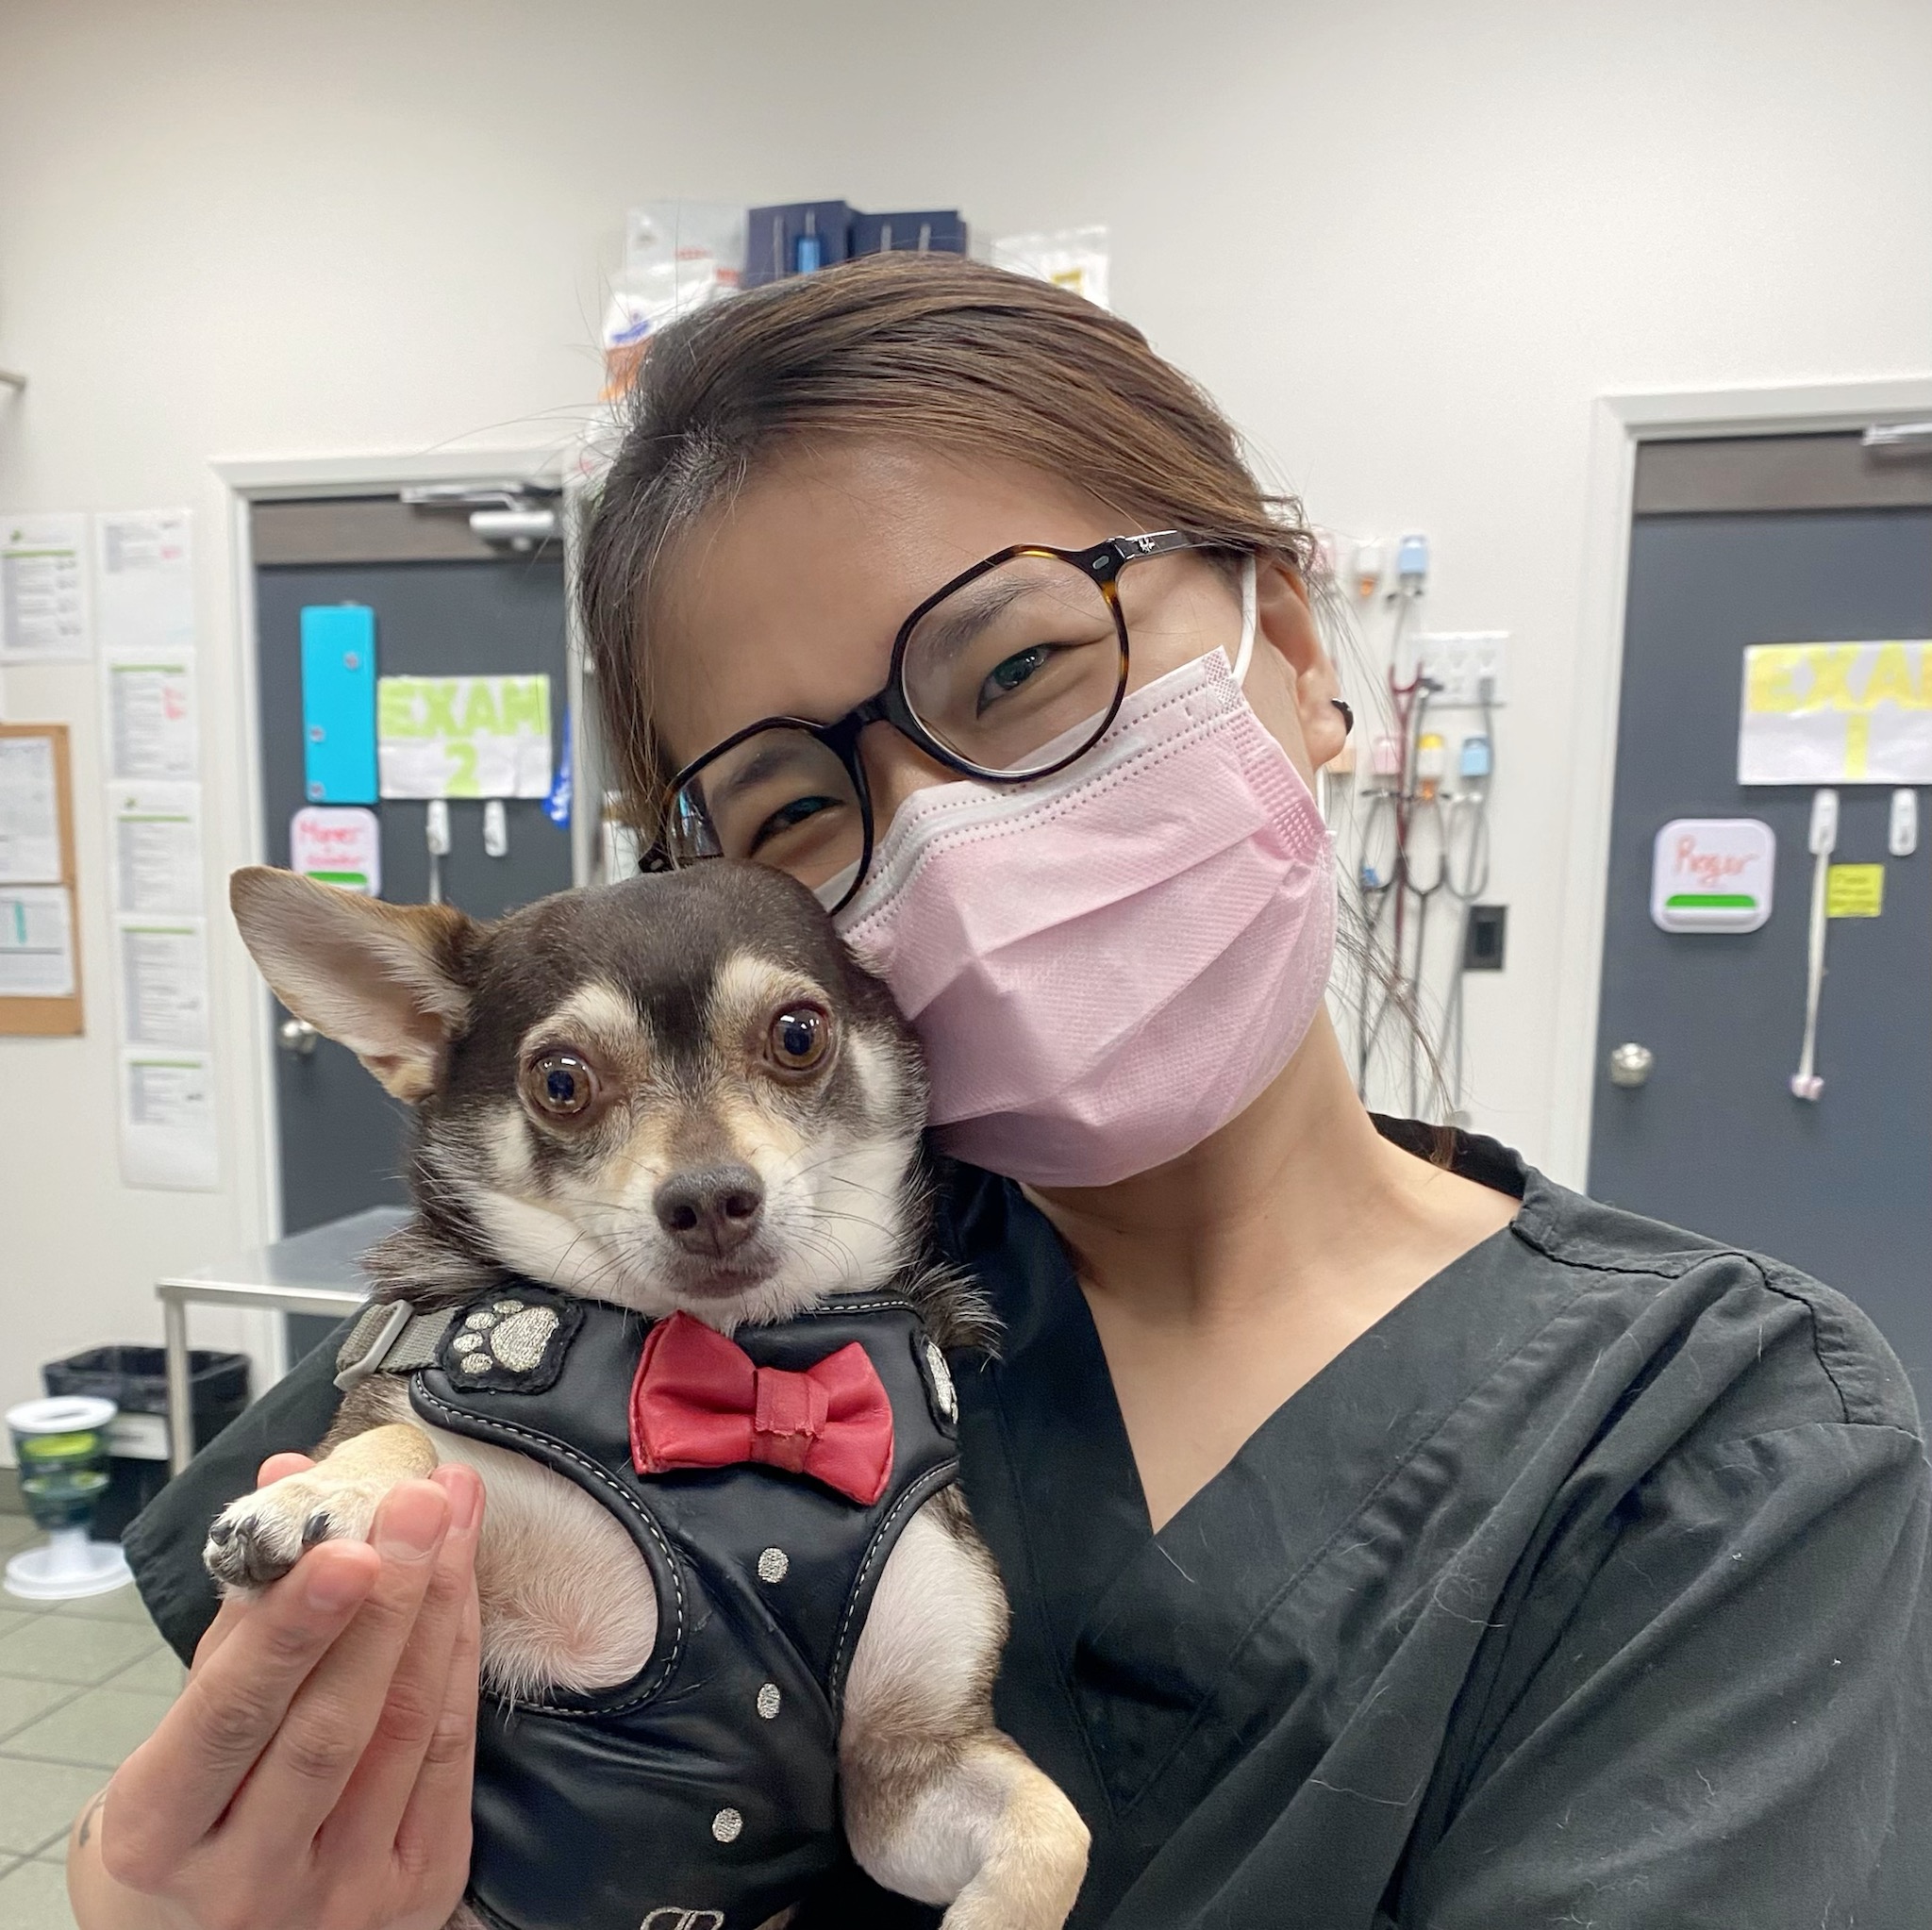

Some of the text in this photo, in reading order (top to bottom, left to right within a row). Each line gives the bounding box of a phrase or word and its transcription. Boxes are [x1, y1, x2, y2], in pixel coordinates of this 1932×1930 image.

[379, 676, 548, 738] EXAM
[1749, 641, 1932, 712] EXA
[443, 740, 479, 797] 2
[1844, 713, 1870, 781] 1
